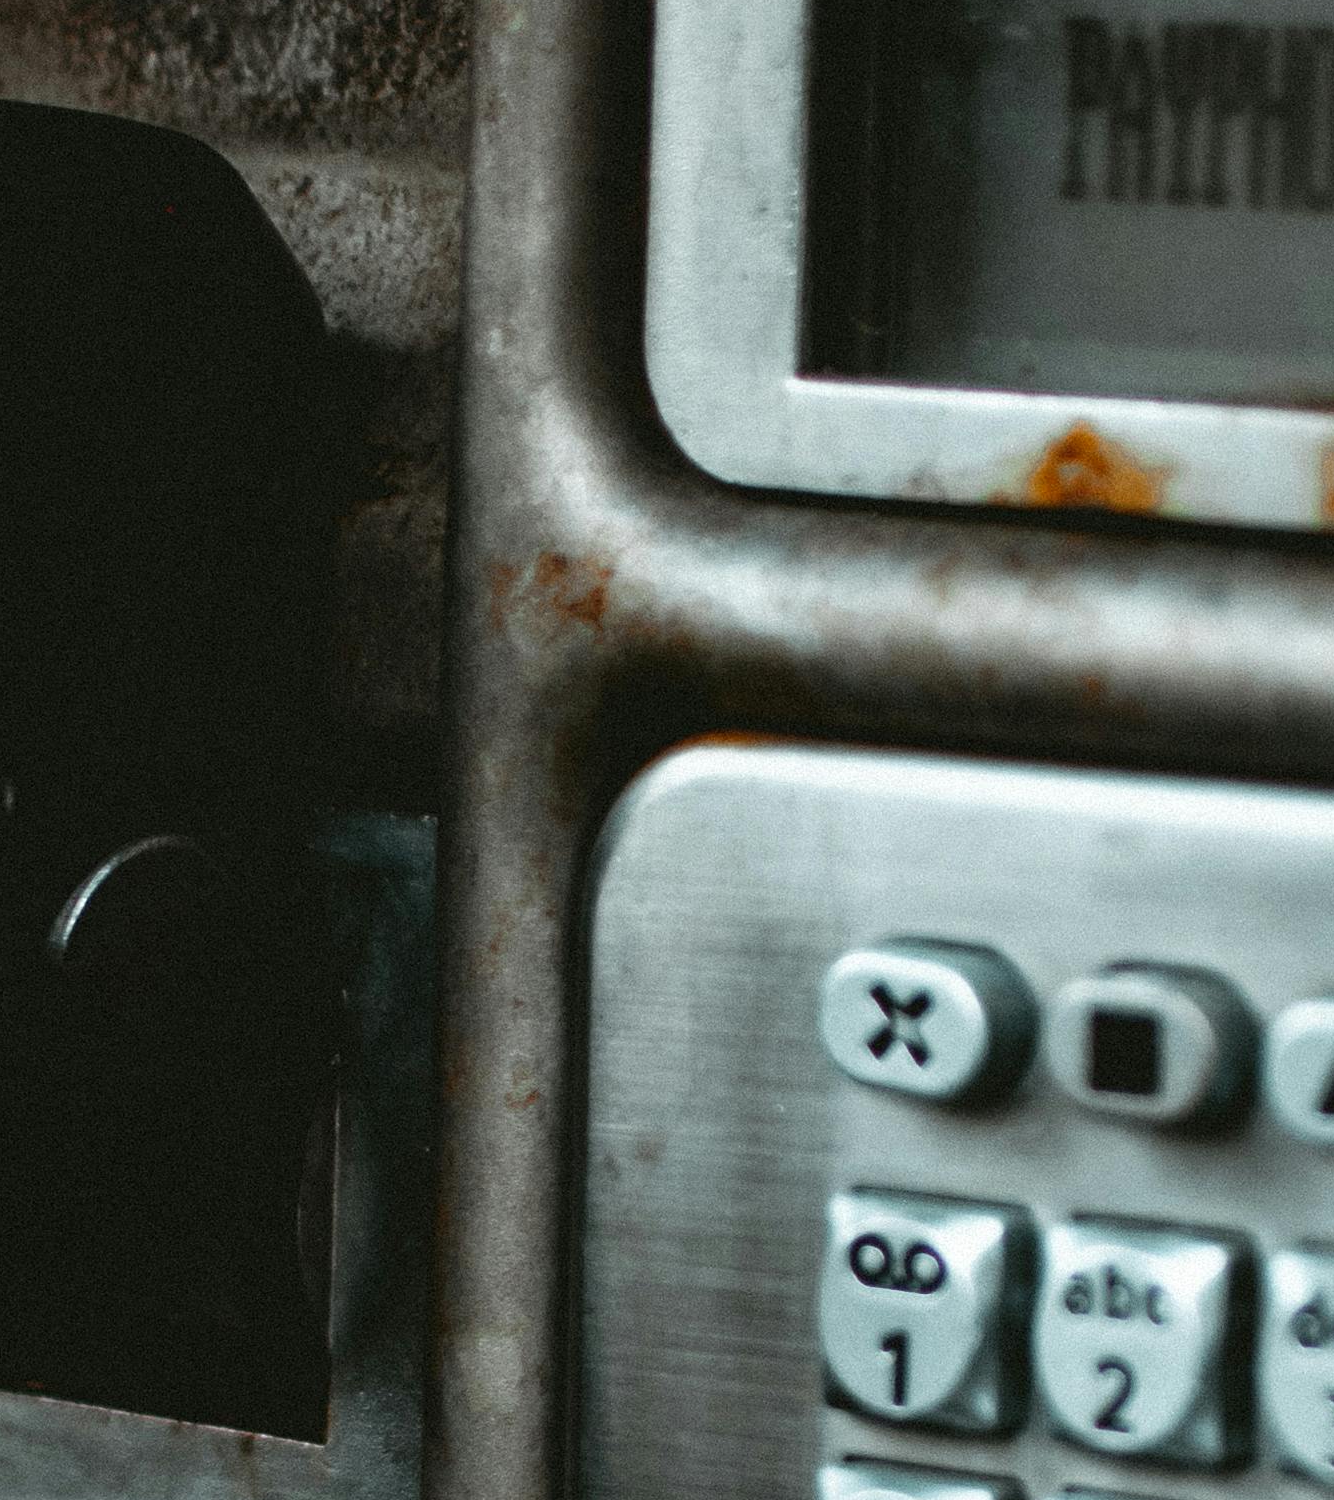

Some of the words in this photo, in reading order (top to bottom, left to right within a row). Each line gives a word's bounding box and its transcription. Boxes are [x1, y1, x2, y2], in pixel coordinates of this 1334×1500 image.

[1064, 1264, 1166, 1326] abc
[881, 1329, 910, 1406] 1
[1094, 1355, 1134, 1433] 2
